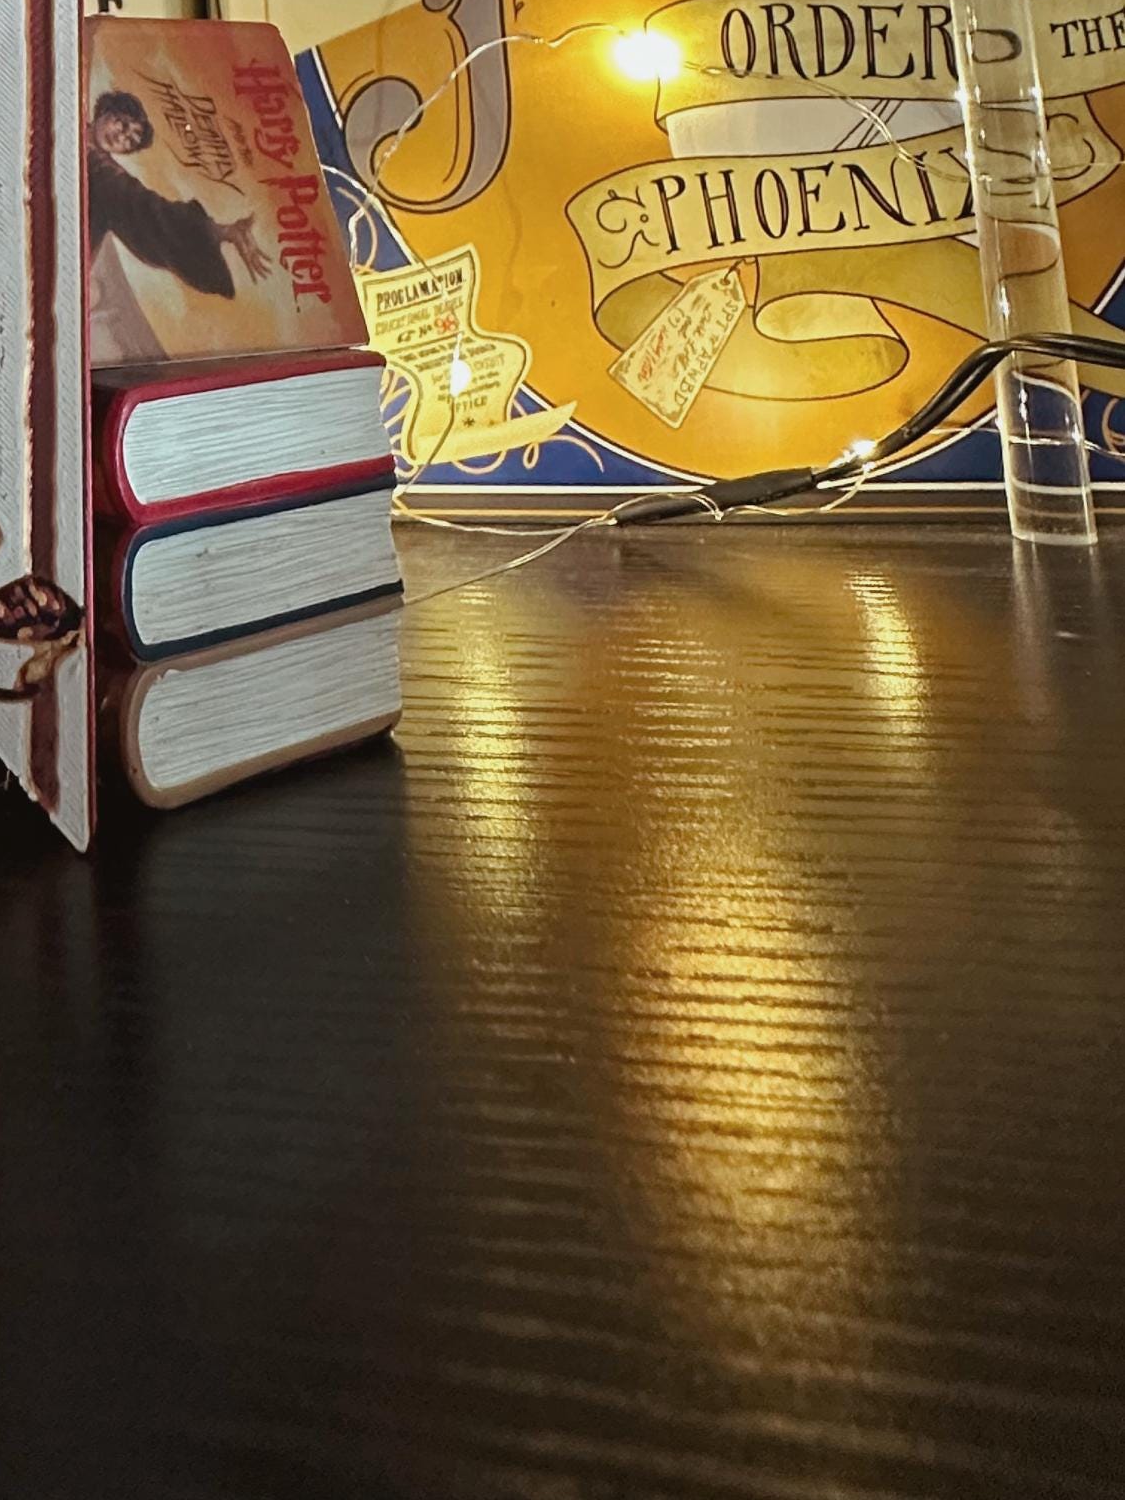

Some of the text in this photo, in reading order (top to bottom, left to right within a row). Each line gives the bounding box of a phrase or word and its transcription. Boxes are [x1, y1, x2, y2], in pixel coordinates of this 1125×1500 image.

[720, 2, 959, 82] ORDER
[232, 58, 333, 304] Harry Potter
